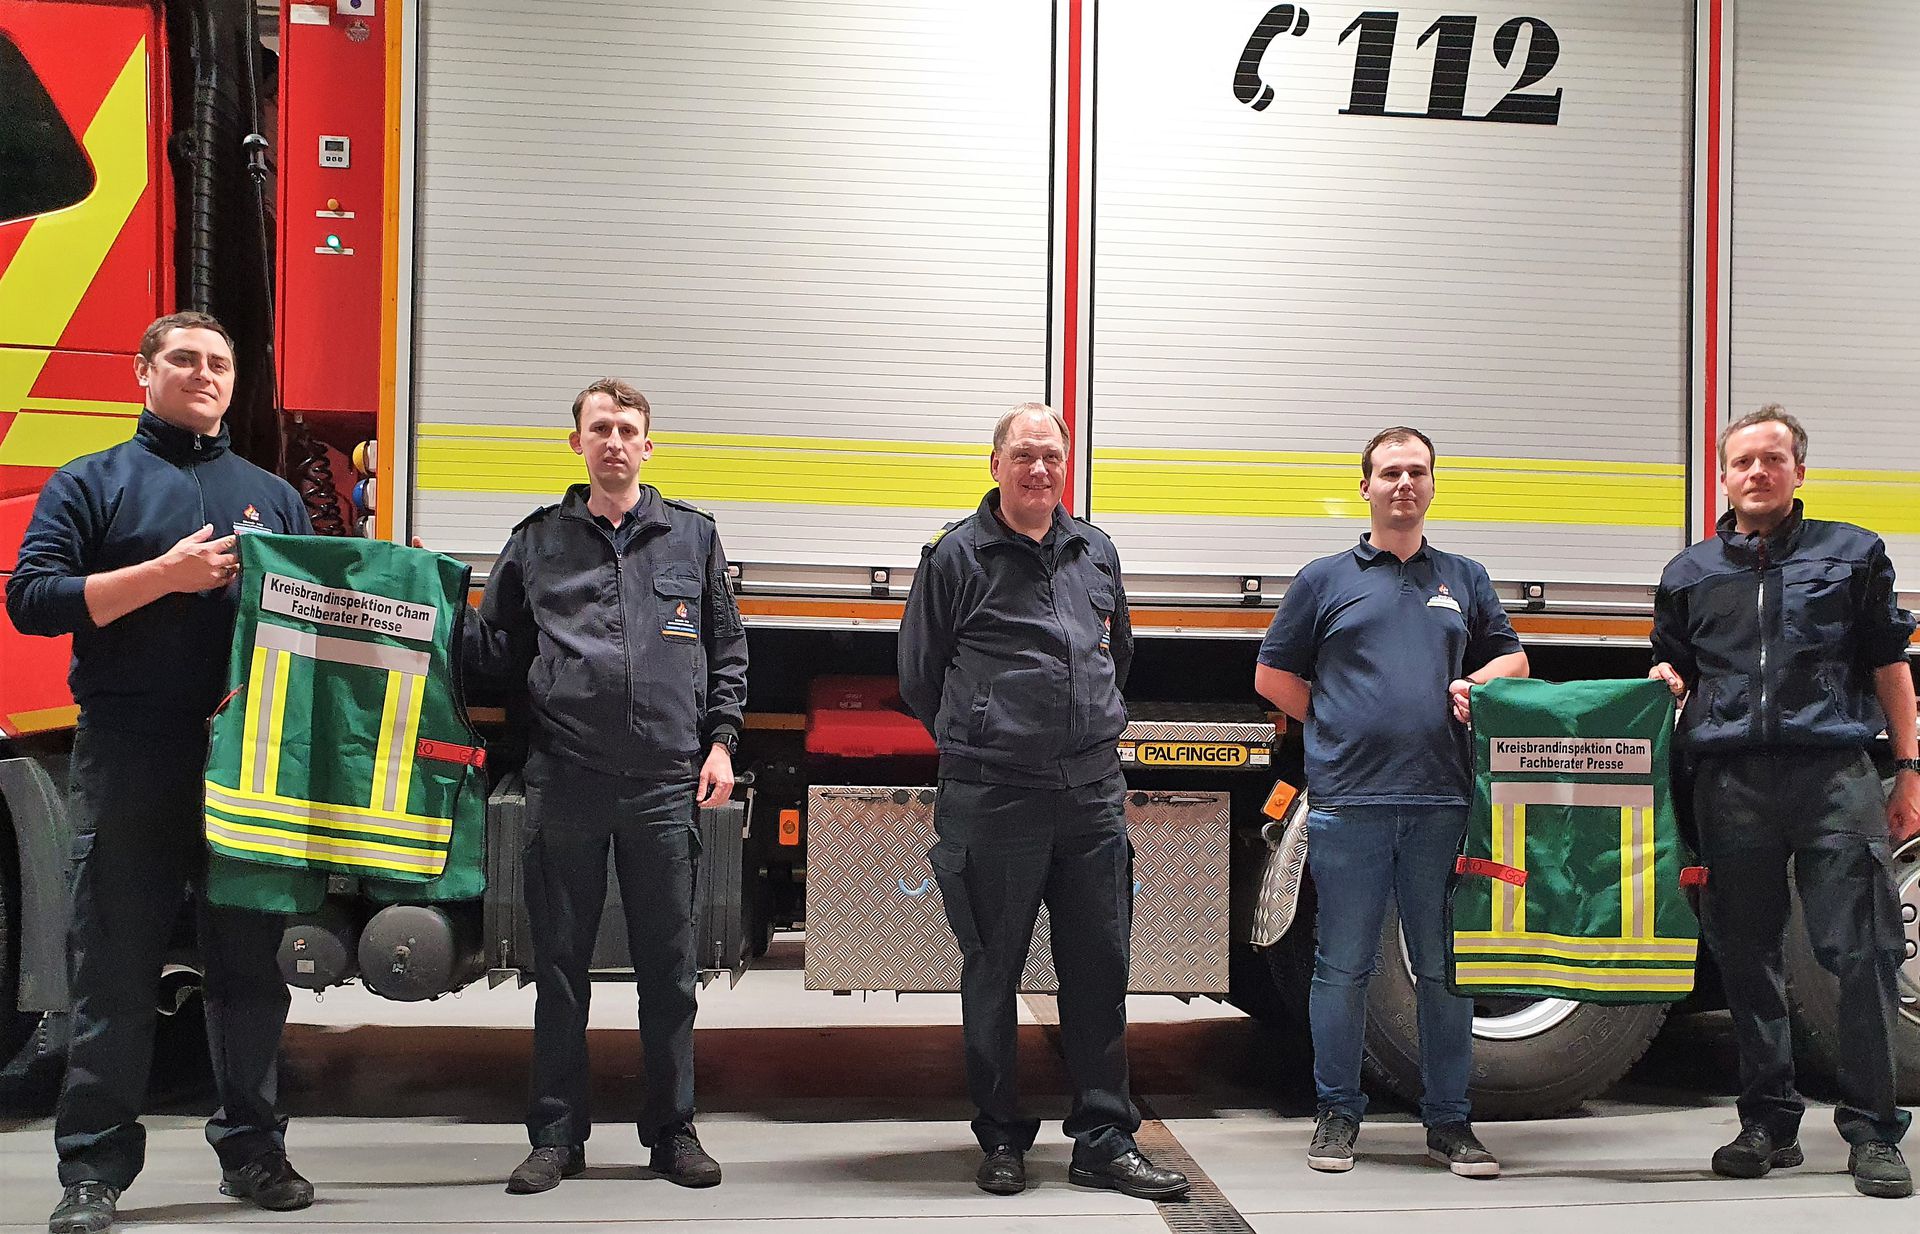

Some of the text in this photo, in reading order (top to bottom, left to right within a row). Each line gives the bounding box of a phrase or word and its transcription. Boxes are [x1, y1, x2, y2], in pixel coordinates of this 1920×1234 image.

[1338, 11, 1563, 125] 112
[270, 577, 430, 622] Kreisbrandinspektion Cham
[291, 600, 403, 633] Fachberater Presse
[1144, 746, 1240, 762] PALFINGER
[1496, 741, 1645, 757] Kreisbrandinspektion Cham
[1520, 756, 1624, 769] Fachberater Presse
